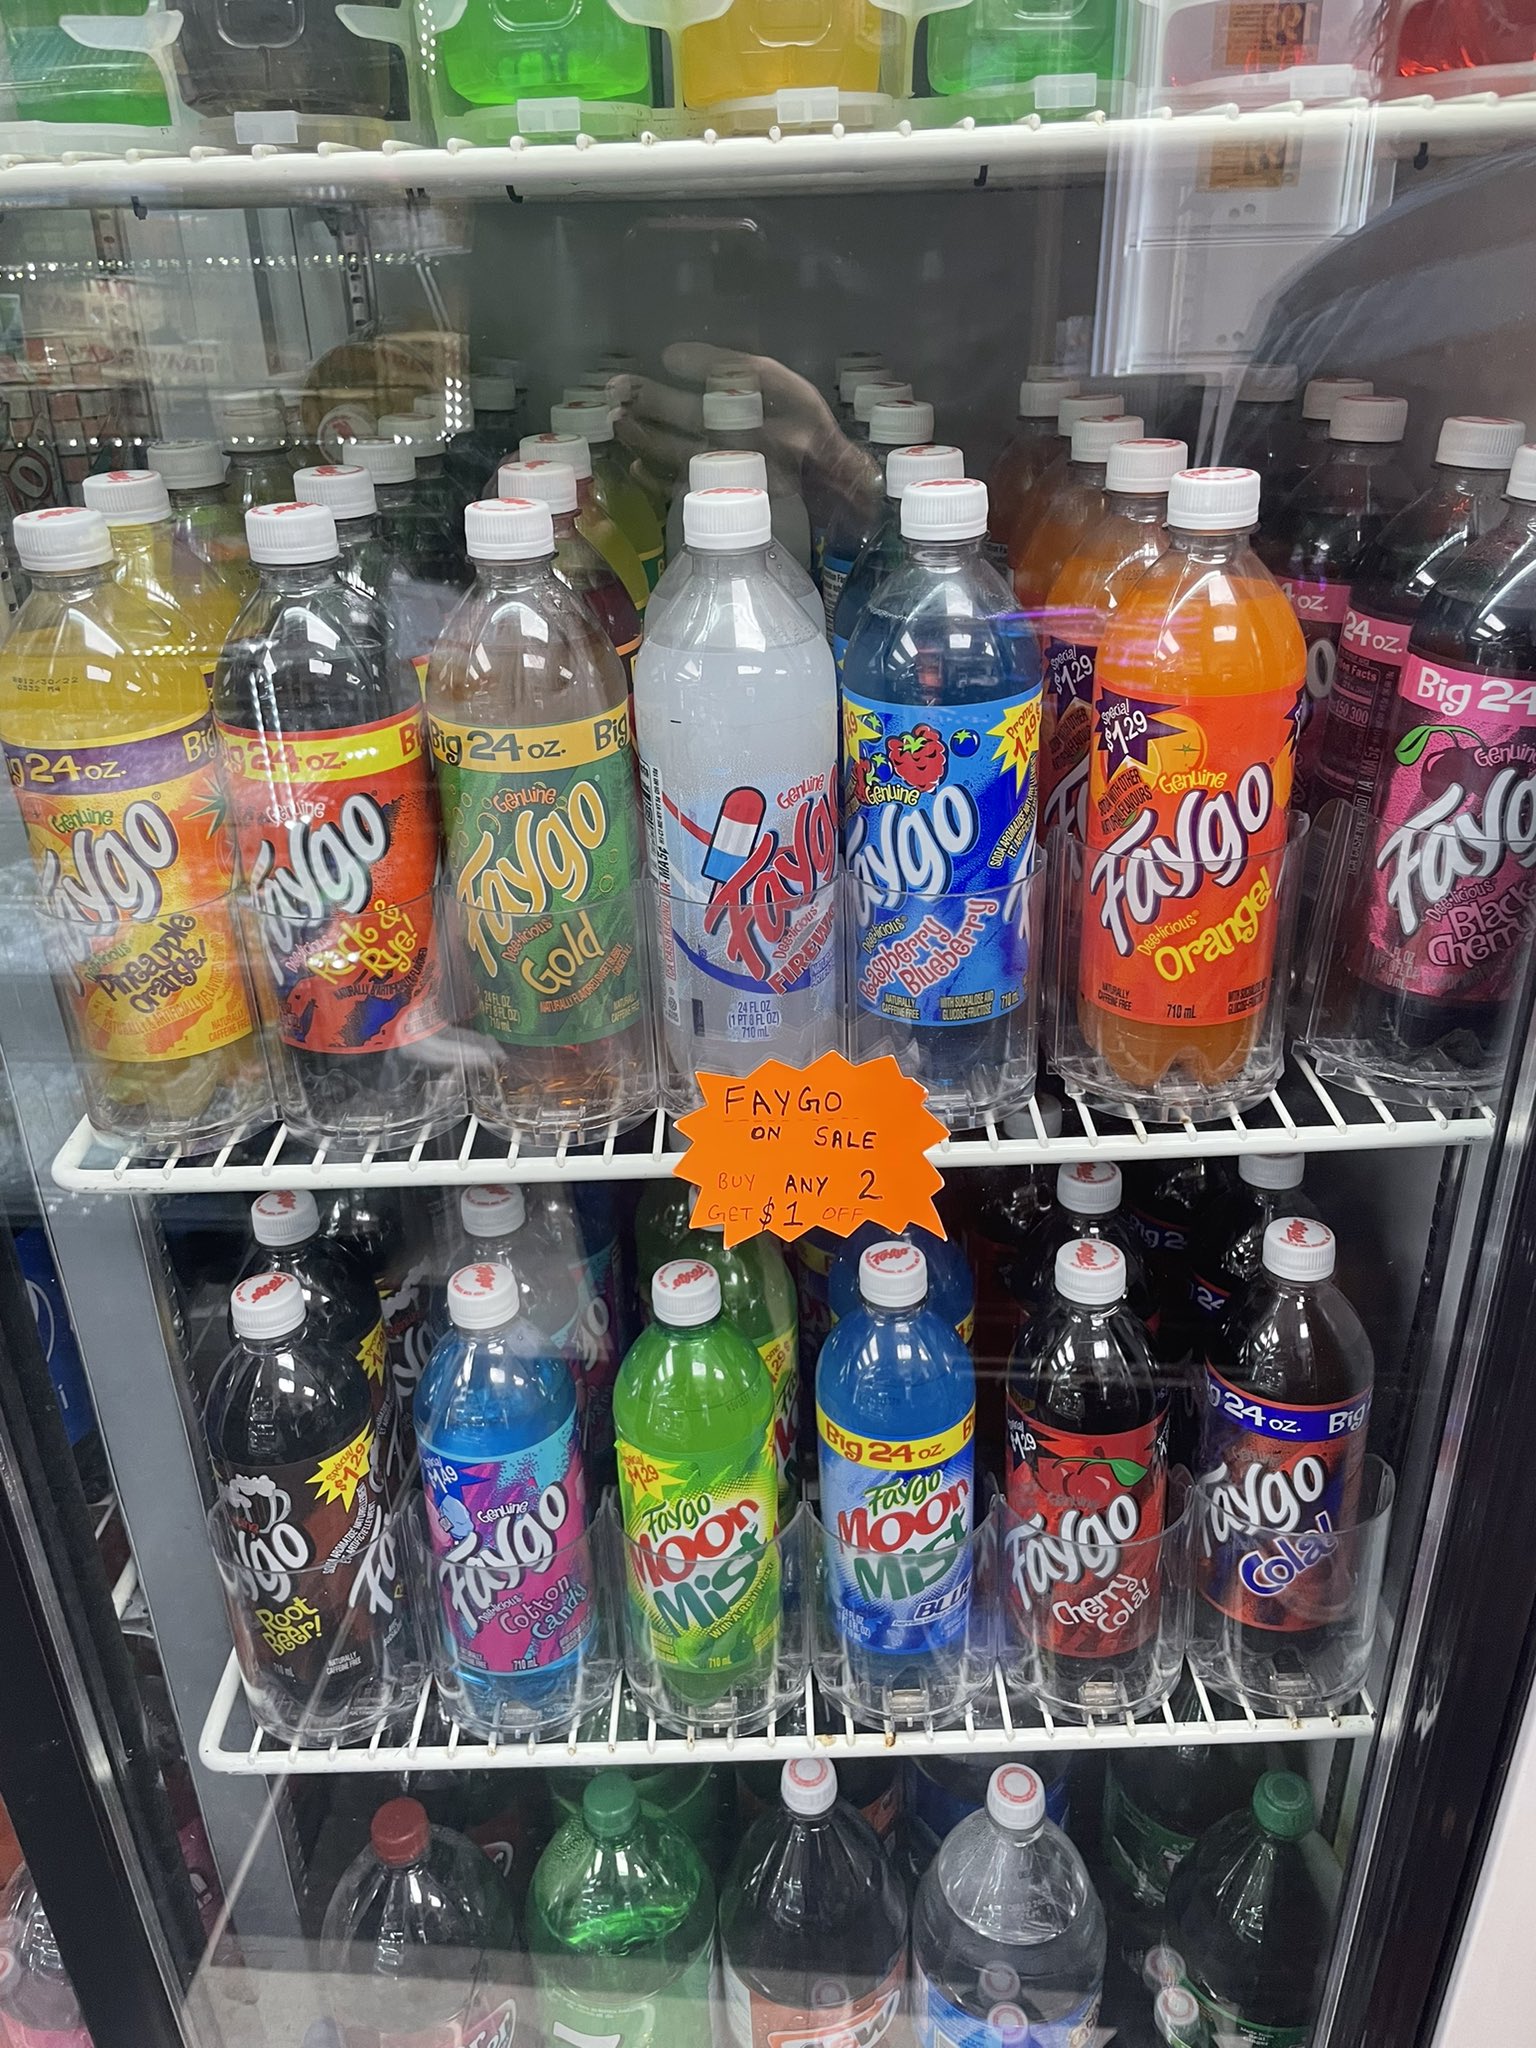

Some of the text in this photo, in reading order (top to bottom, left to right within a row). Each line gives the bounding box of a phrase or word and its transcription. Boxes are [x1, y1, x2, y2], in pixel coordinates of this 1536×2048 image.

[1053, 654, 1093, 696] $1.29
[1417, 665, 1472, 717] Big
[1477, 679, 1536, 717] 24
[593, 712, 629, 752] Big
[1005, 701, 1034, 740] Promo
[1104, 709, 1148, 755] $1.29
[182, 724, 218, 764] Big
[247, 740, 348, 774] 24 oz.
[430, 719, 567, 767] Big 24 oz.
[25, 753, 82, 784] 24
[84, 761, 128, 781] oz.
[1118, 766, 1142, 794] OTHER
[1158, 769, 1228, 796] Genuine
[493, 786, 557, 813] Genuine
[776, 772, 826, 811] Genuine
[865, 783, 921, 807] Genuine
[1119, 782, 1154, 822] FLAVOURS
[50, 807, 115, 835] Genuine
[1089, 761, 1274, 958] Faygo
[1375, 767, 1536, 937] Fayg
[456, 780, 609, 978] Faygo
[373, 899, 402, 930] &
[1154, 864, 1273, 982] Orange!
[98, 912, 198, 1002] Pineapple
[360, 912, 419, 979] Rye!
[519, 909, 605, 995] Gold
[859, 915, 955, 1003] Raspberry
[897, 898, 998, 997] Blueberry
[539, 997, 575, 1013] NATURALLY
[573, 980, 601, 1006] FLAVORED
[737, 1000, 771, 1013] 24 FL OZ
[881, 1003, 920, 1020] CAFFEINE FREE
[884, 991, 917, 1008] NATURALLY
[1118, 997, 1133, 1012] FREE
[1167, 1003, 1197, 1019] 710 mL
[738, 1013, 747, 1026] PT
[756, 1013, 765, 1026] FL
[767, 1012, 780, 1026] OZ)
[741, 1025, 770, 1039] 710 mL
[724, 1085, 843, 1116] FAYGO
[750, 1125, 878, 1150] ON SALE
[717, 1169, 884, 1201] BUY ANY 2
[707, 1203, 754, 1222] GET
[821, 1206, 866, 1222] OFF
[1223, 1391, 1302, 1433] 24 oz.
[1328, 1407, 1366, 1435] Big
[825, 1420, 946, 1464] Big 24 oz.
[334, 1442, 366, 1491] $1.29
[476, 1499, 529, 1524] Genuine
[864, 1469, 945, 1517] Faygo
[642, 1493, 712, 1543] Faygo
[837, 1478, 970, 1554] Moon
[438, 1481, 567, 1632] Faygo
[629, 1497, 760, 1592] Moon
[1004, 1494, 1139, 1612] Faygo
[1238, 1509, 1339, 1597] Cola!
[254, 1595, 320, 1636] Root
[499, 1575, 570, 1635] Cotton
[530, 1582, 589, 1640] Candy
[1052, 1572, 1139, 1626] Cherry
[1096, 1576, 1150, 1634] Cola!
[261, 1614, 323, 1657] Beer!
[708, 1619, 733, 1640] With
[731, 1611, 742, 1623] A
[326, 1655, 362, 1676] CAFFEINE FREE
[328, 1650, 358, 1668] NATURALLY
[513, 1659, 527, 1671] 710
[708, 1657, 721, 1669] 710
